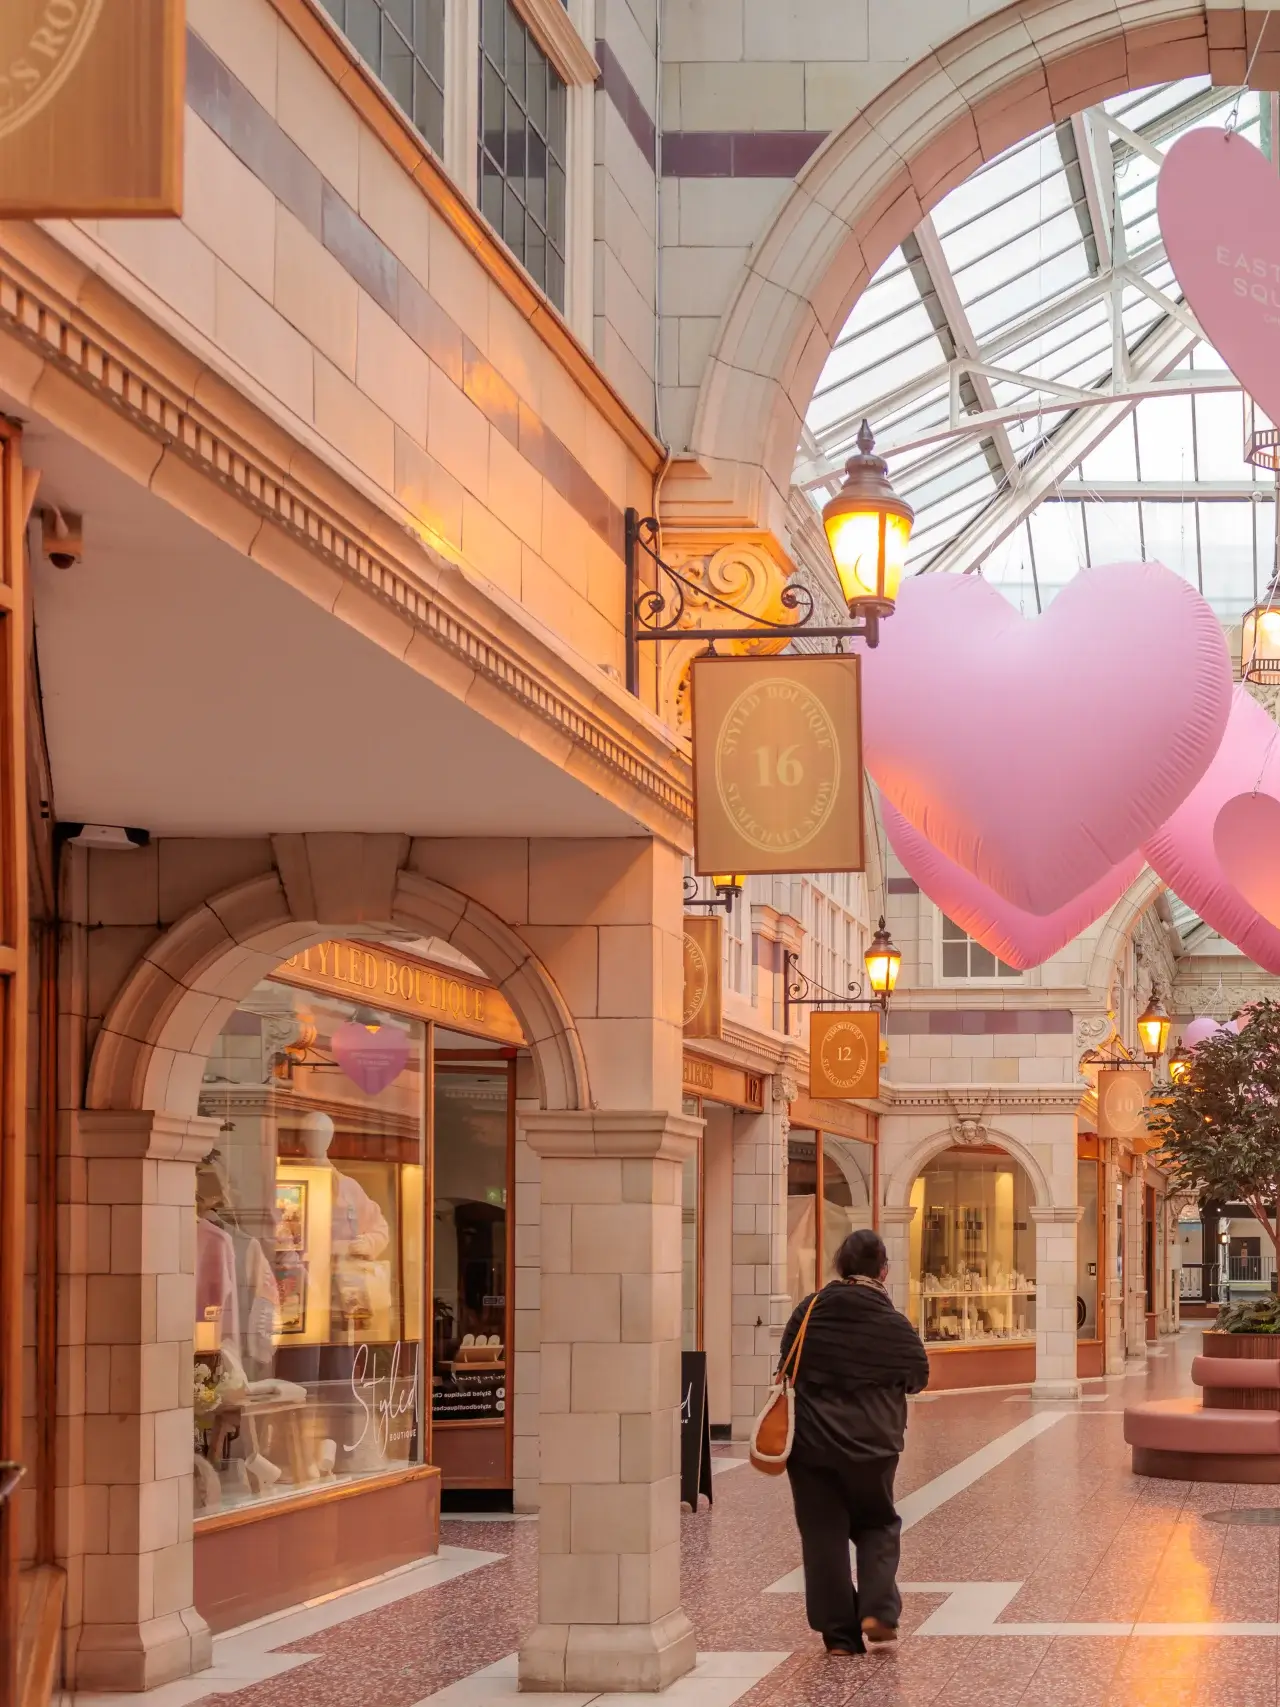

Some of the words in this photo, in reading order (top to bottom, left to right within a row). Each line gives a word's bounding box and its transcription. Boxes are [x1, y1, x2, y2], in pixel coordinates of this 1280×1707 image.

[723, 693, 761, 757] STYLED
[765, 685, 833, 750] BOUTIQUE
[751, 743, 804, 788] 16
[810, 781, 833, 817] ROW
[384, 959, 485, 1022] BOUTIQUE
[837, 1046, 852, 1061] 12
[856, 1057, 867, 1075] ROW
[751, 1079, 759, 1102] 12
[343, 1340, 419, 1459] Styled
[389, 1428, 417, 1442] BOUTIQUE
